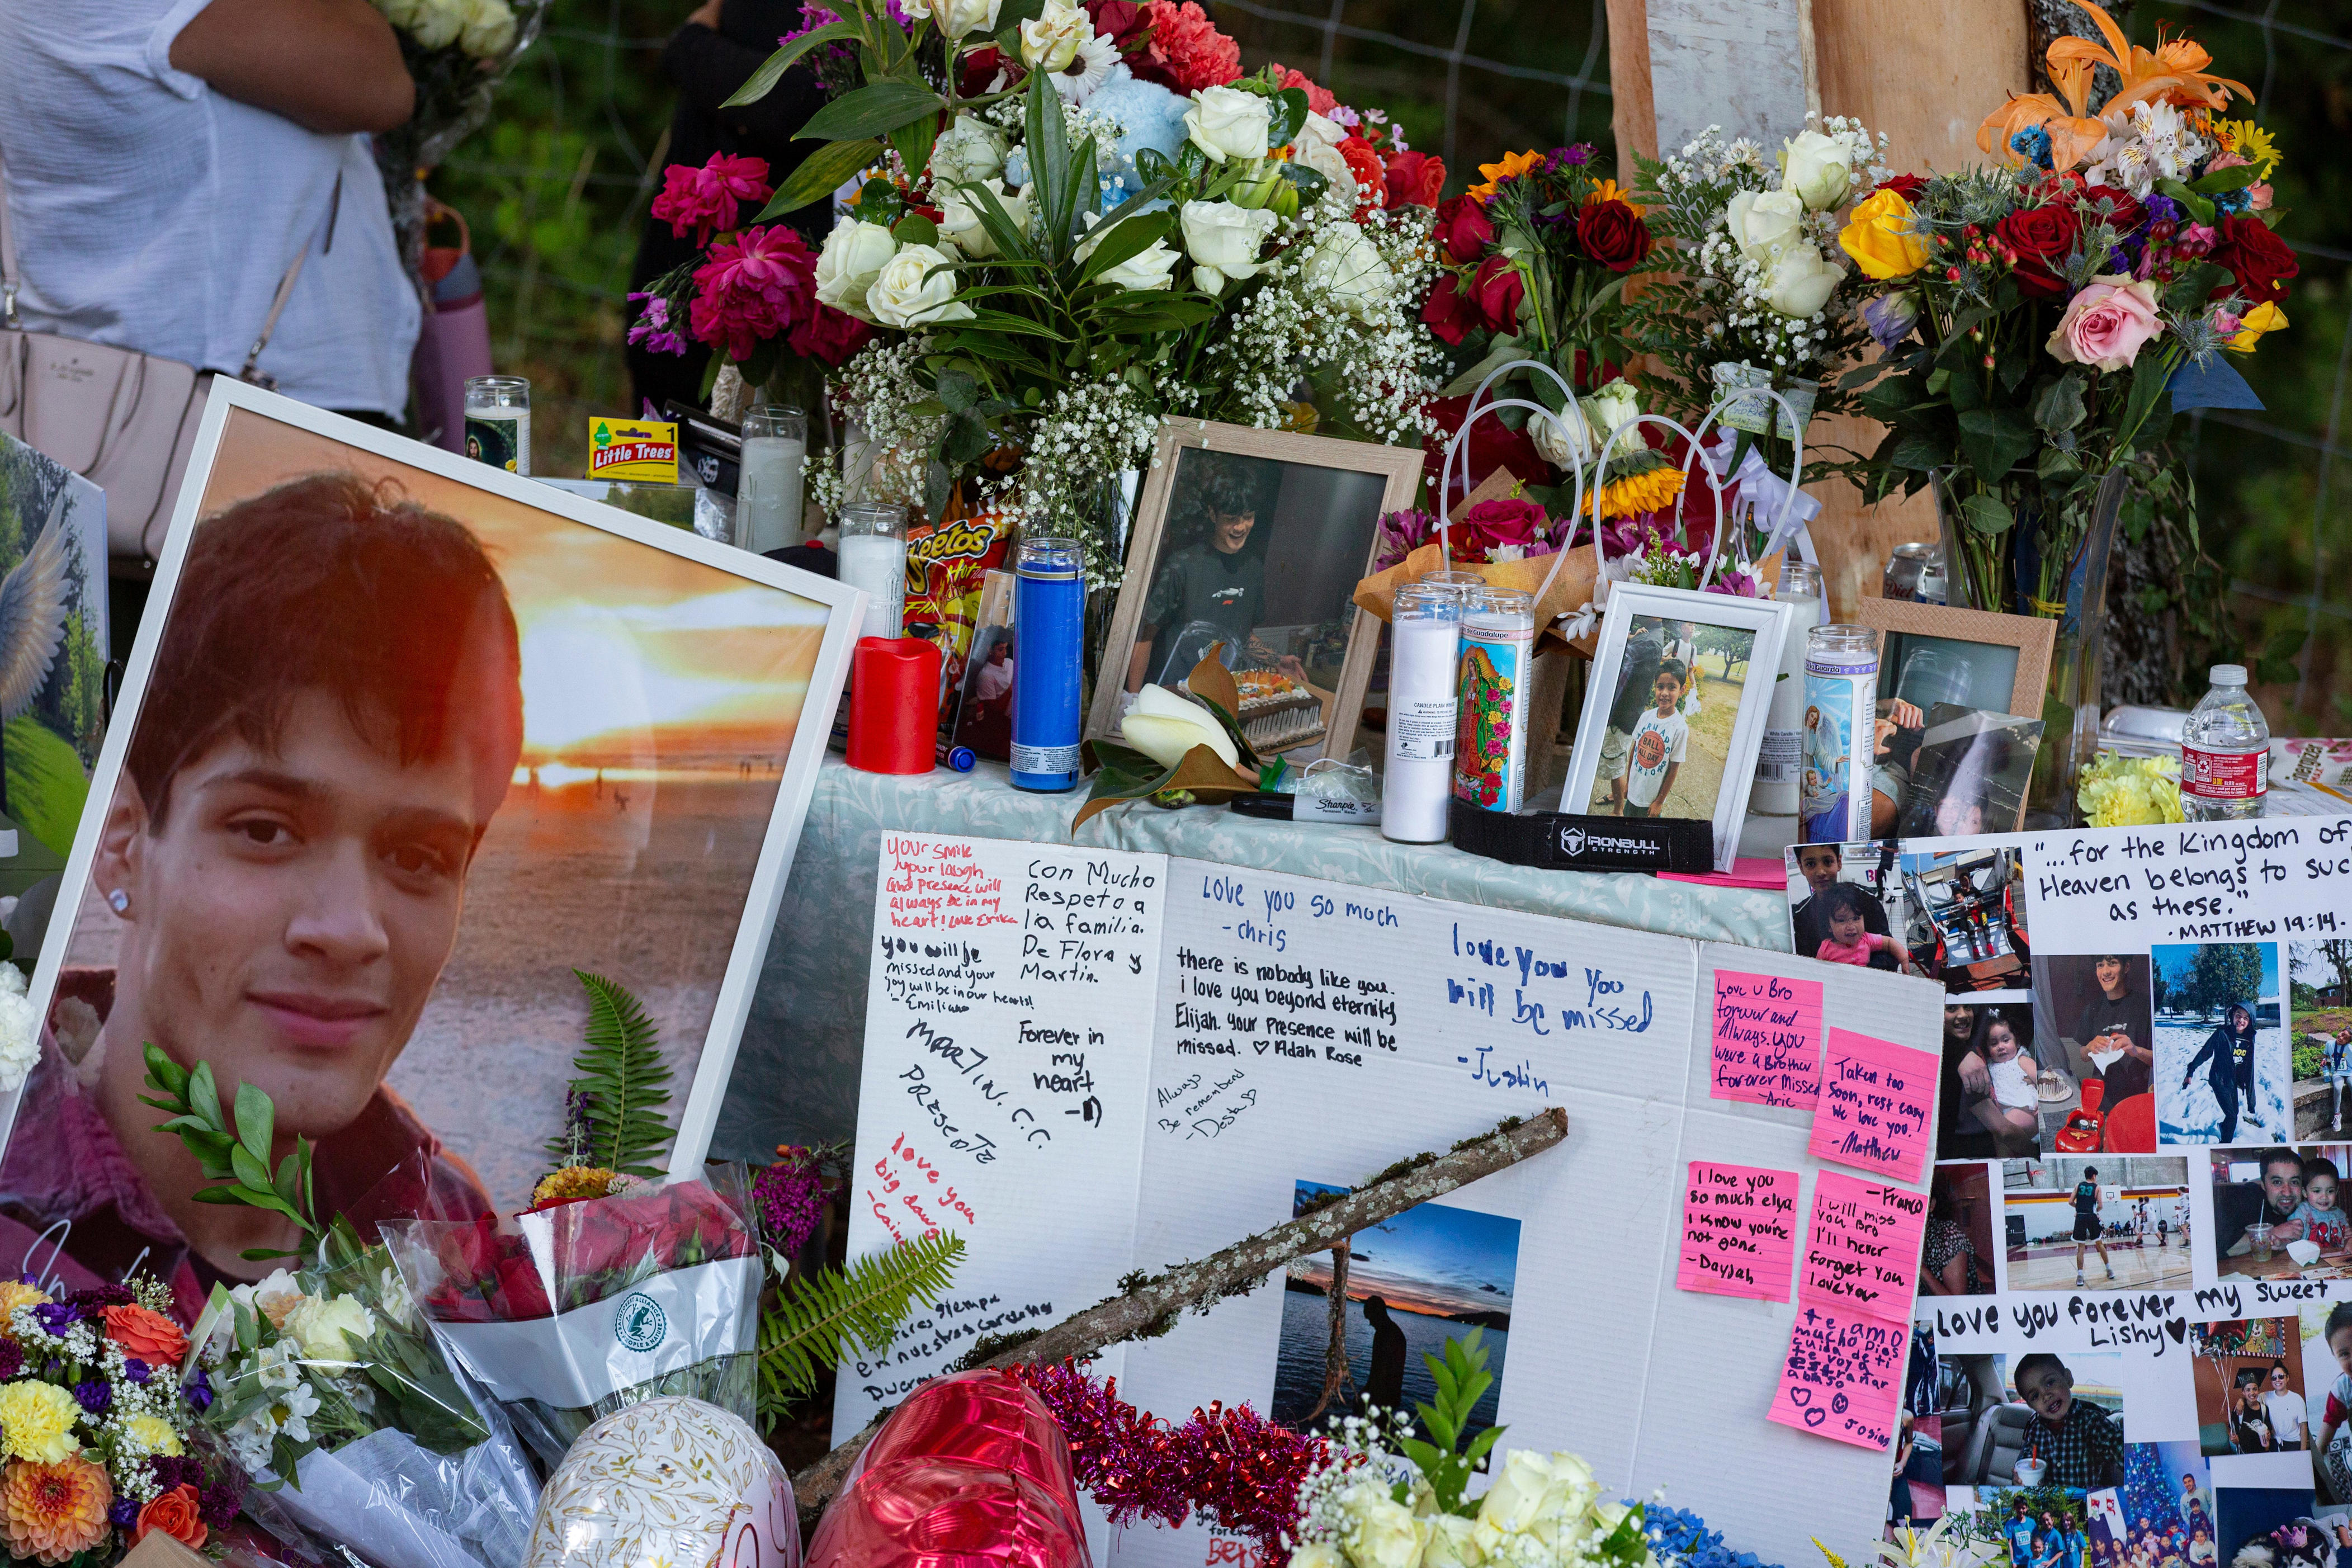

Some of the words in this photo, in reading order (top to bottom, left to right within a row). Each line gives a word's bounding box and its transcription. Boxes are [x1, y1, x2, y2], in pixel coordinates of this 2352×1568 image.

[667, 427, 674, 442] 1
[595, 446, 632, 468] Little
[636, 444, 673, 459] Trees
[946, 559, 981, 582] Hot
[1886, 579, 1914, 597] Diet
[1473, 630, 1508, 639] Guadalupe
[1643, 737, 1659, 751] BALL
[1647, 753, 1659, 762] DAY
[1316, 799, 1356, 810] Sharpie
[1588, 835, 1660, 850] IRONBULL
[1592, 847, 1655, 855] STRENGTH
[2122, 836, 2164, 858] the
[2180, 825, 2299, 863] Kingdom
[2319, 820, 2351, 844] of
[899, 861, 934, 880] your
[941, 863, 983, 884] laugh
[1029, 860, 1073, 880] Con
[1088, 861, 1154, 888] Mucho
[2039, 874, 2130, 901] Heaven
[2146, 866, 2247, 892] belongs
[2260, 858, 2287, 884] to
[975, 878, 1002, 893] will
[890, 896, 943, 914] always
[947, 894, 962, 906] be
[966, 895, 977, 906] in
[982, 897, 1000, 913] my
[1026, 883, 1124, 910] Respeto
[1134, 901, 1144, 914] a
[1264, 889, 1295, 922] you
[1347, 901, 1398, 927] much
[2109, 901, 2137, 922] as
[881, 935, 918, 960] you
[925, 942, 957, 957] will
[961, 941, 981, 967] be
[1023, 934, 1049, 957] De
[1060, 940, 1114, 961] Flora
[886, 962, 934, 976] missed
[938, 965, 961, 979] and
[966, 970, 995, 989] your
[1177, 946, 1223, 972] there
[1234, 957, 1248, 975] is
[1257, 964, 1312, 989] nobody
[1321, 969, 1350, 989] like
[910, 981, 932, 992] will
[936, 981, 949, 995] be
[954, 985, 964, 998] in
[967, 991, 987, 999] our
[1717, 977, 1747, 994] Love
[1769, 977, 1792, 1000] Bro
[1194, 976, 1222, 999] love
[1231, 985, 1258, 1005] you
[1266, 988, 1325, 1013] beyond
[1332, 996, 1397, 1026] eternity
[1512, 989, 1550, 1035] be
[1562, 990, 1652, 1033] missed
[1770, 1010, 1798, 1027] and
[1018, 1020, 1080, 1046] Forever
[1089, 1027, 1104, 1045] in
[1227, 1012, 1257, 1032] your
[1344, 1026, 1371, 1047] will
[1377, 1029, 1397, 1052] be
[1052, 1053, 1084, 1075] my
[1326, 1046, 1362, 1066] Rose
[1753, 1053, 1760, 1069] a
[1835, 1057, 1877, 1084] Taken
[1887, 1073, 1904, 1090] too
[1158, 1074, 1201, 1108] Always
[1858, 1111, 1878, 1126] love
[1868, 1094, 1893, 1112] rest
[1899, 1103, 1924, 1132] easy
[1158, 1119, 1180, 1134] Be
[875, 1157, 900, 1193] big
[891, 1131, 939, 1183] love
[938, 1187, 974, 1225] you
[1698, 1169, 1702, 1184] I
[1709, 1169, 1738, 1187] love
[1747, 1175, 1774, 1193] you
[1716, 1192, 1754, 1206] much
[2079, 1186, 2093, 1196] 33
[1689, 1213, 1692, 1224] I
[1819, 1194, 1822, 1207] I
[1829, 1201, 1856, 1217] will
[1864, 1211, 1896, 1225] miss
[1688, 1230, 1713, 1243] not
[1856, 1219, 1878, 1238] Bro
[1817, 1226, 1836, 1246] I'll
[1847, 1236, 1889, 1257] never
[1809, 1250, 1868, 1280] forget
[618, 1297, 634, 1330] RAINFOREST
[636, 1297, 660, 1317] ALLIANCE
[2014, 1300, 2059, 1339] you
[2068, 1295, 2175, 1326] forever
[2194, 1284, 2242, 1316] my
[2257, 1279, 2329, 1303] sweet
[621, 1335, 643, 1347] PEOPLE
[650, 1323, 662, 1344] NATURE
[1803, 1309, 1836, 1329] te
[1850, 1324, 1902, 1347] amo
[2090, 1318, 2165, 1357] Lishy
[1792, 1337, 1841, 1356] cuida
[1852, 1349, 1869, 1363] de
[1876, 1355, 1892, 1369] ti
[1795, 1326, 1858, 1347] mucho
[1865, 1341, 1898, 1358] Dios
[1792, 1345, 1817, 1360] te
[1827, 1354, 1852, 1372] voy
